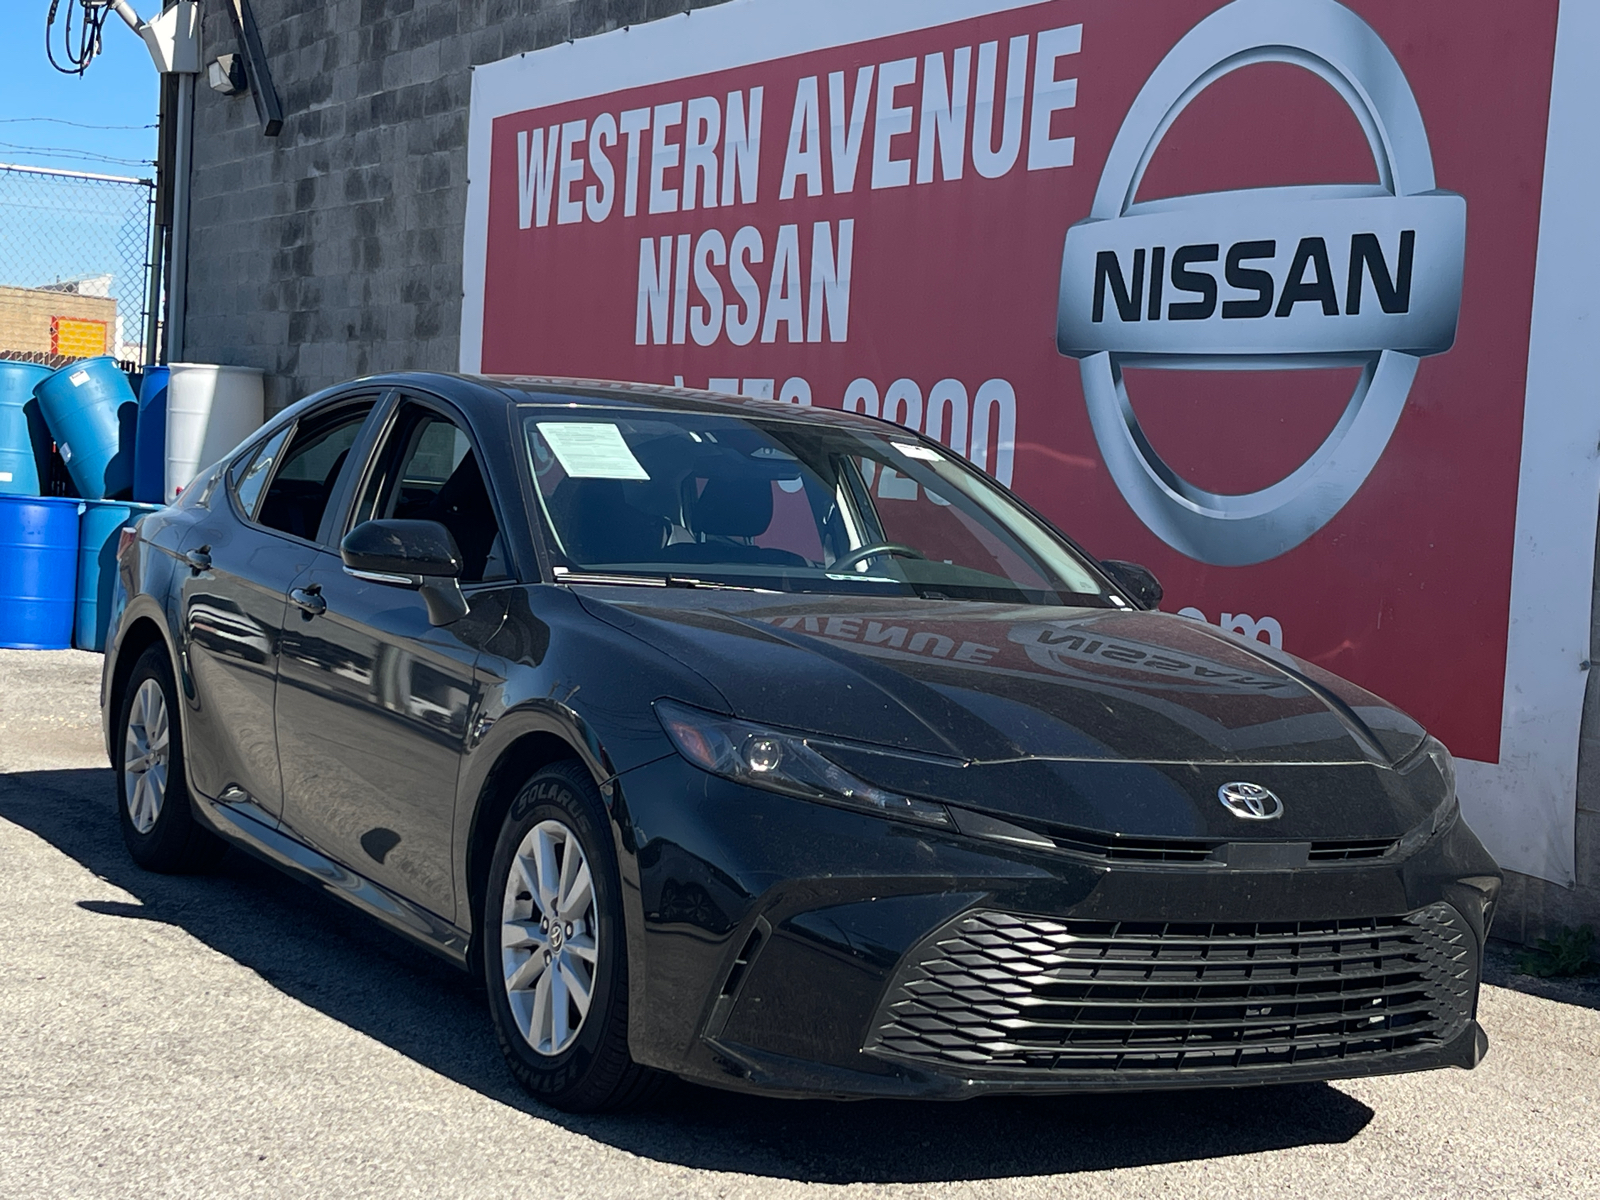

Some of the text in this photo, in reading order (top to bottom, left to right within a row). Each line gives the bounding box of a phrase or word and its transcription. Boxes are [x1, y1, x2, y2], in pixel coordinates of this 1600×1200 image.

[516, 23, 1083, 230] WESTERN AVENUE
[635, 218, 855, 347] NISSAN
[1091, 230, 1416, 322] NISSAN
[517, 782, 592, 833] SOLARUS
